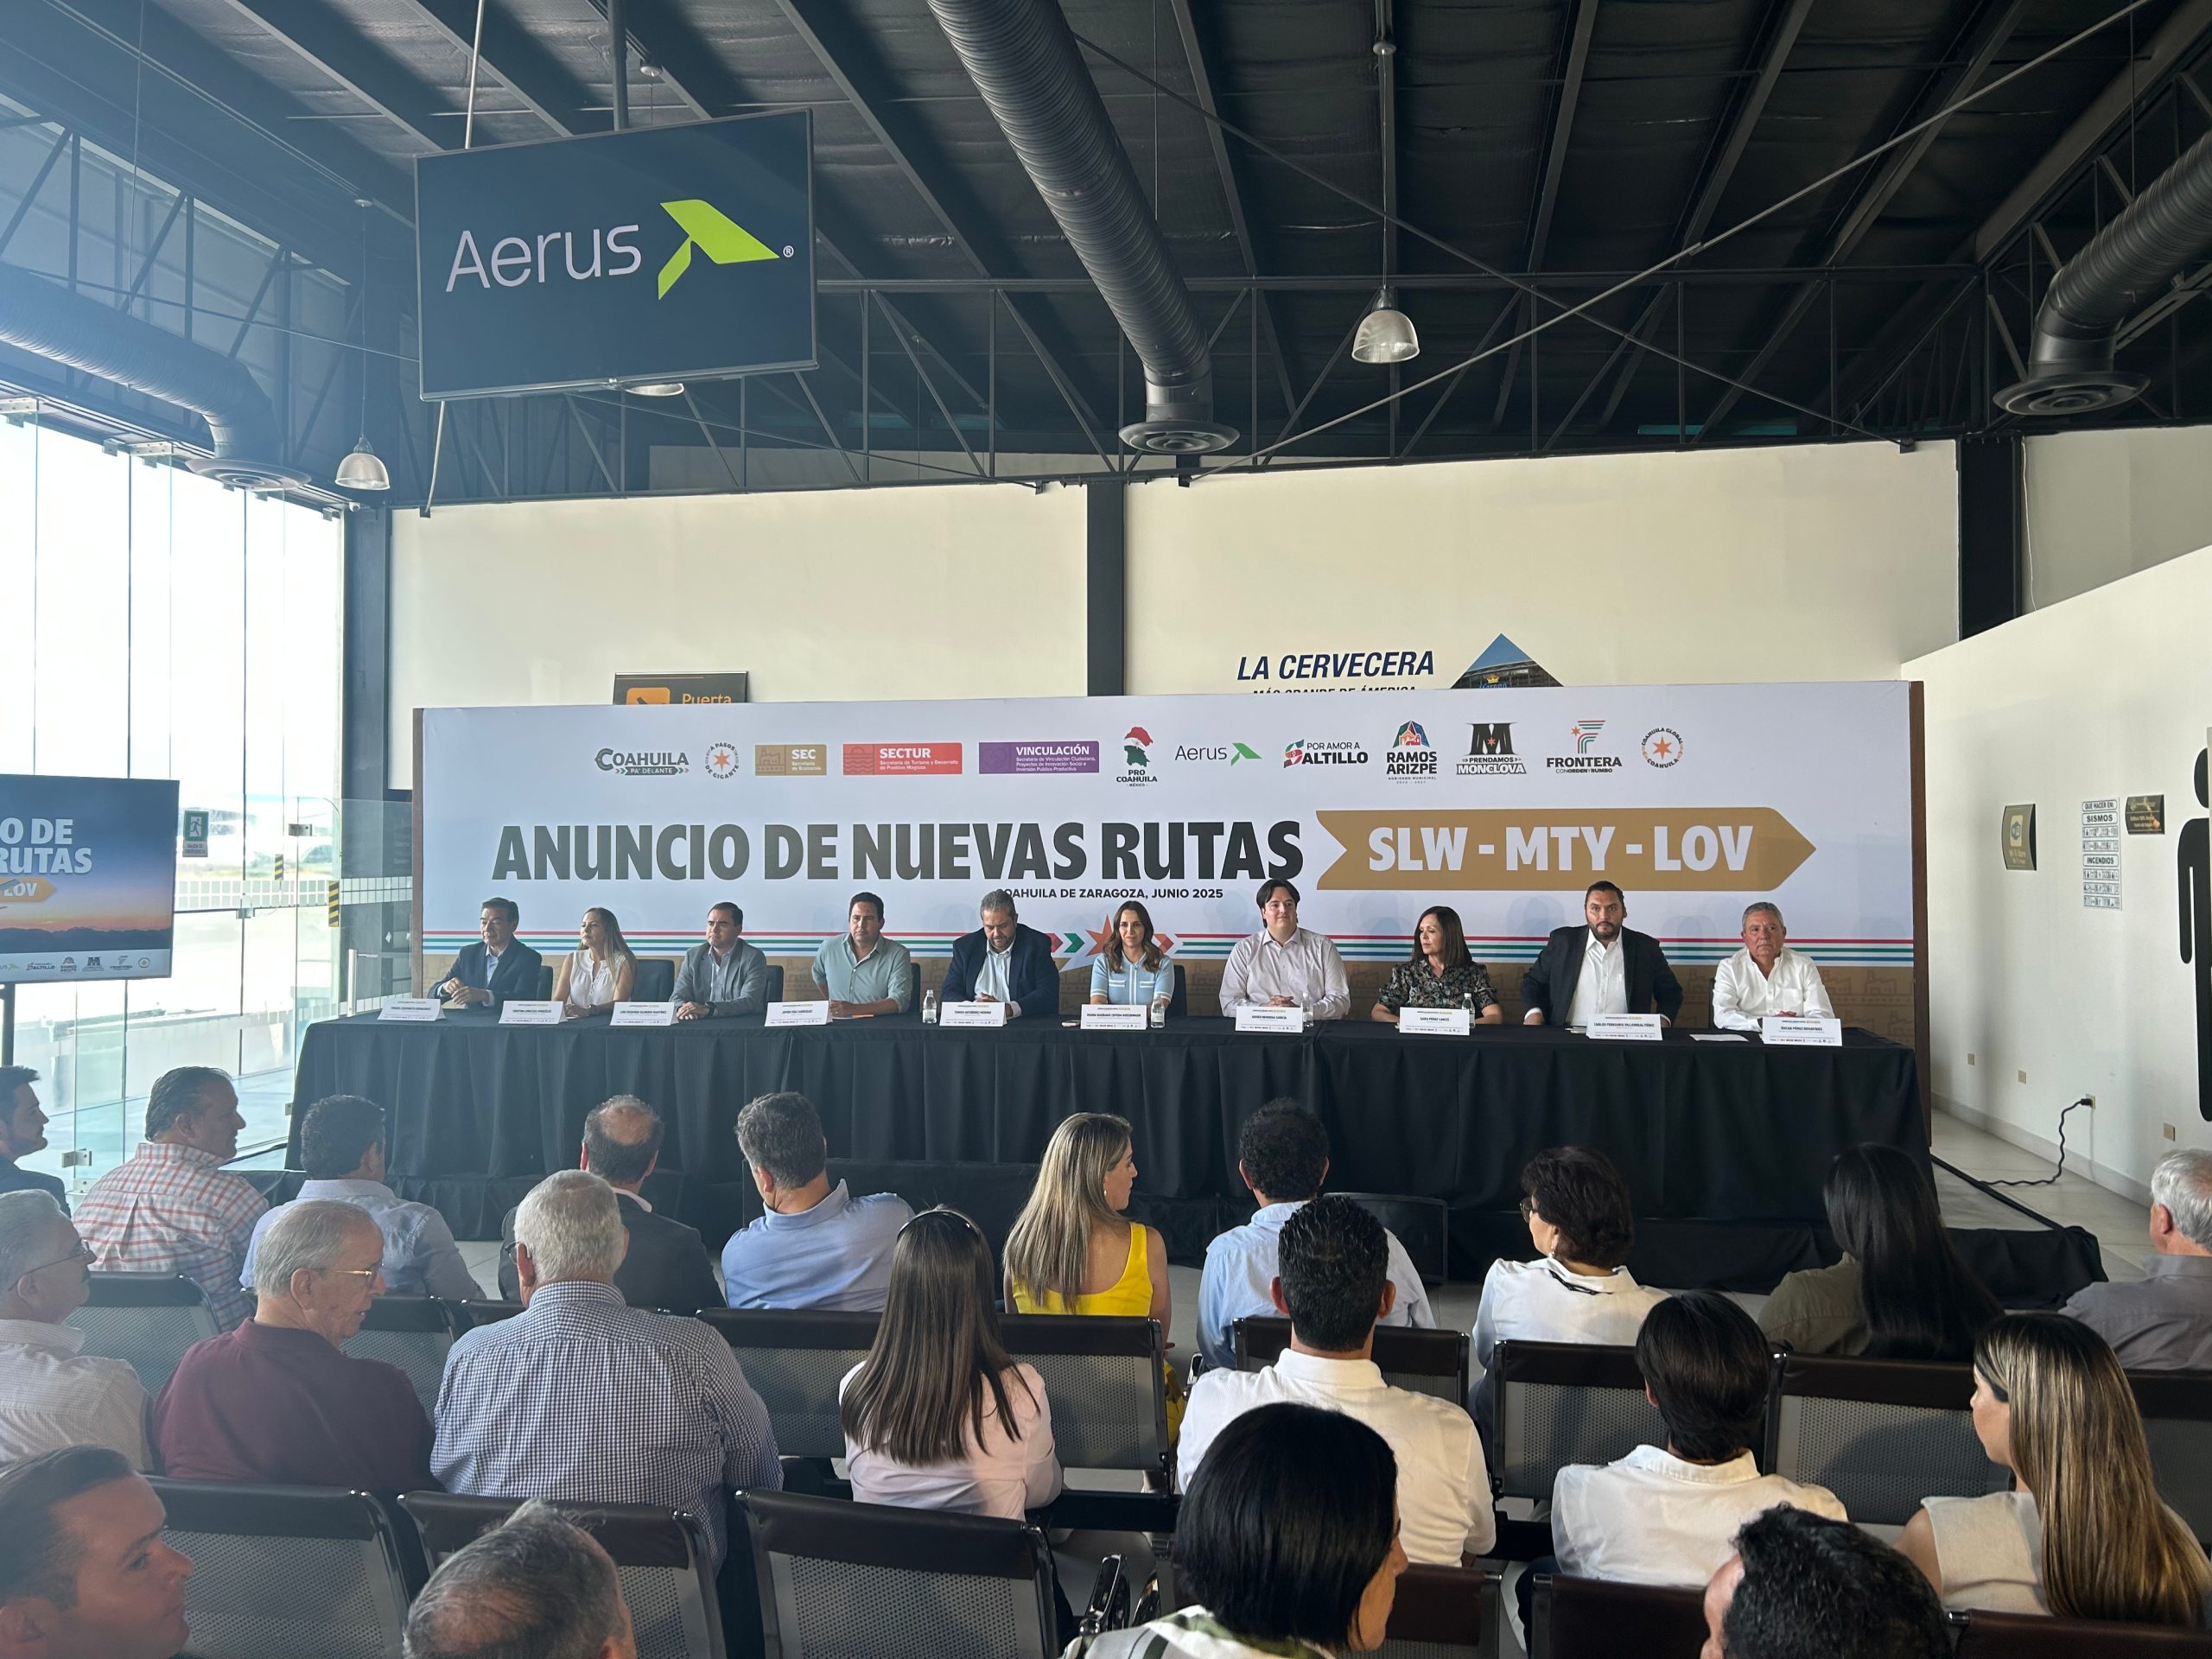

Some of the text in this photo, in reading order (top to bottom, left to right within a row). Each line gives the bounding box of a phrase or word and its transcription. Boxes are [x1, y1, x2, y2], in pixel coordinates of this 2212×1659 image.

[445, 225, 642, 292] Aerus
[1237, 651, 1434, 680] LA CERVECERA
[791, 749, 816, 760] SEC
[880, 748, 931, 759] SECTUR
[1016, 744, 1090, 755] VINCULACIÓN
[1175, 745, 1228, 760] Aerus
[594, 748, 690, 771] COAHUILA
[1386, 752, 1437, 763] RAMOS
[1547, 757, 1622, 767] FRONTERA
[1386, 763, 1437, 774] ARIZPE
[1457, 764, 1527, 774] MONCLOVA
[1647, 759, 1679, 768] COAHUILA
[31, 818, 73, 845] DE
[492, 823, 750, 880] ANUNCIO
[764, 823, 838, 880] DE
[853, 822, 1087, 880] NUEVAS
[1102, 821, 1303, 880] RUTAS
[1369, 827, 1468, 871] SLW
[1506, 826, 1616, 871] MTY
[1654, 825, 1753, 871] LOV
[1006, 888, 1224, 899] OAHUILA DE ZARAGOZA, JUNIO 2025
